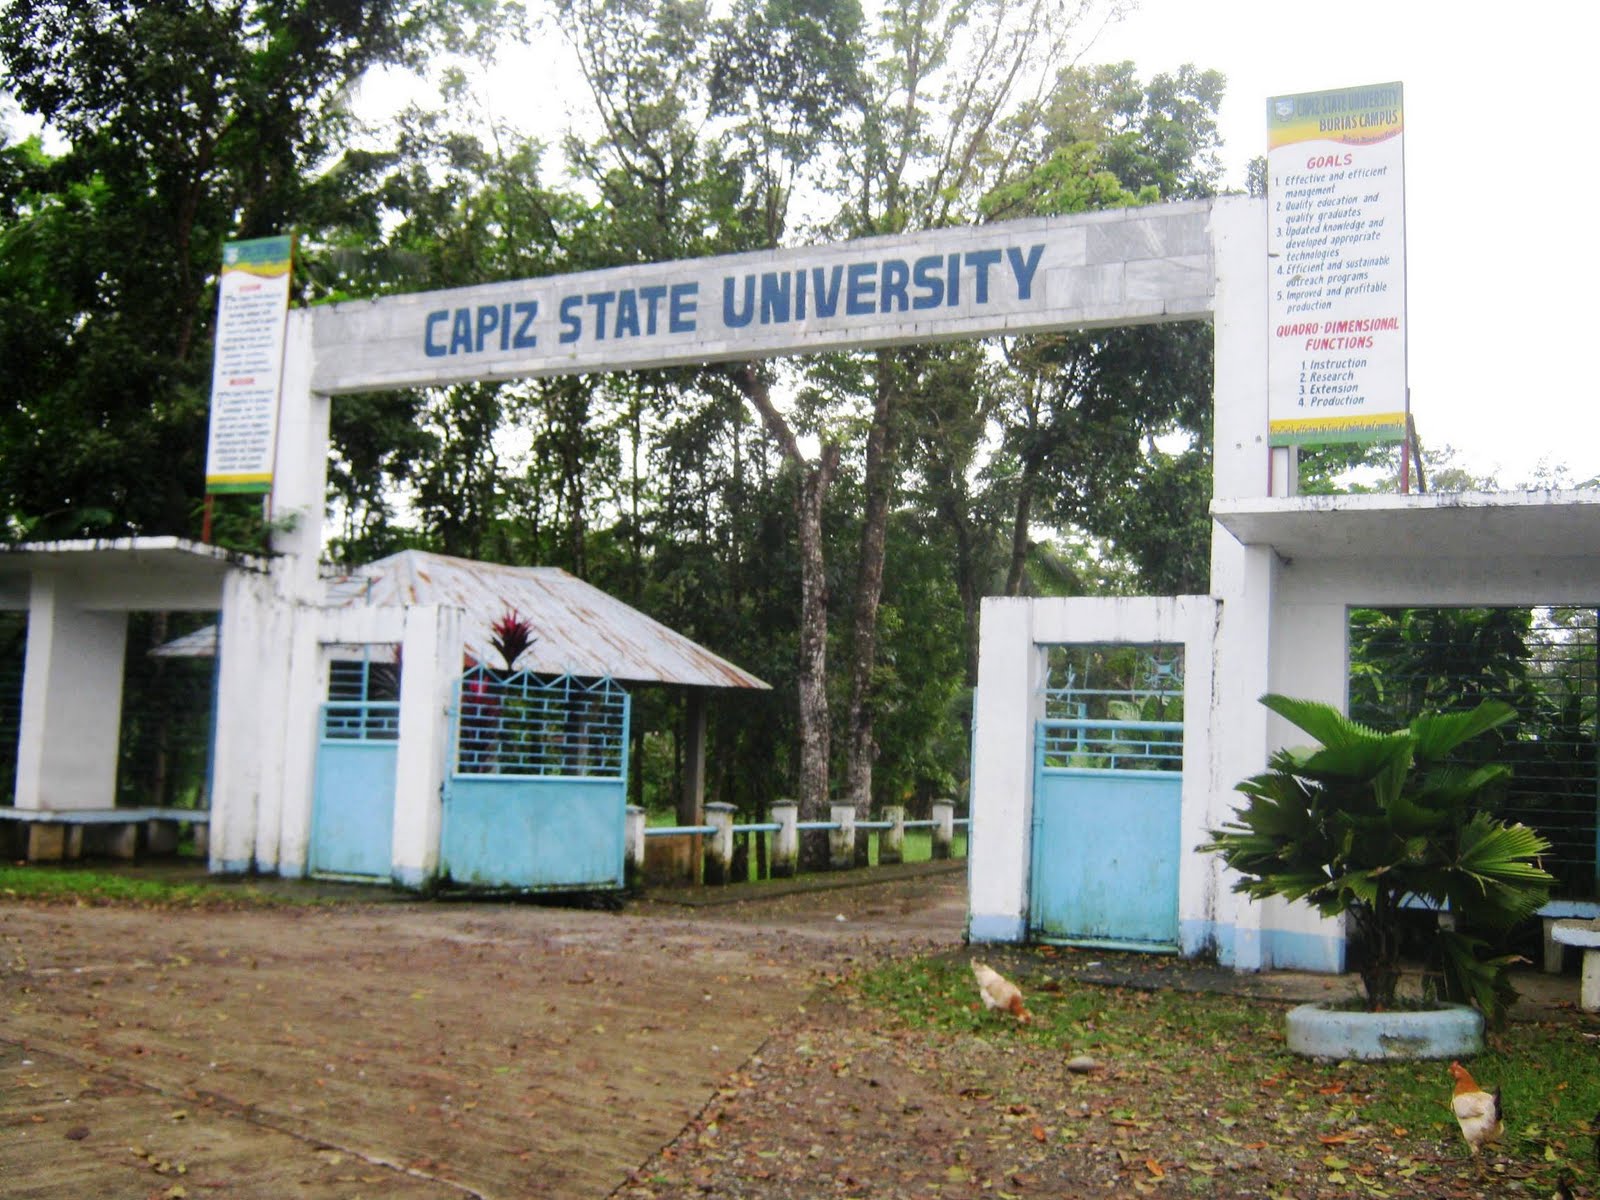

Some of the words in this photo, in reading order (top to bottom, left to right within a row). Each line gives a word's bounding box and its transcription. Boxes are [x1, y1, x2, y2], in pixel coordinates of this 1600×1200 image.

[1320, 117, 1357, 132] BURIAS
[1359, 109, 1398, 128] CAMPUS
[1307, 153, 1352, 169] GOALS
[1285, 172, 1325, 186] Effective
[1329, 171, 1344, 182] and
[1348, 166, 1387, 179] efficient
[1285, 185, 1335, 199] management
[1285, 200, 1312, 211] Quality
[1317, 196, 1357, 208] education
[1364, 193, 1379, 203] and
[1286, 214, 1313, 225] quality
[1318, 208, 1361, 223] graduates
[1286, 224, 1320, 238] Updated
[1323, 221, 1365, 232] knowledge
[1369, 217, 1384, 227] and
[1286, 236, 1327, 249] developed
[1331, 231, 1381, 245] appropriate
[1287, 248, 1339, 262] technologies
[1287, 261, 1324, 274] Efficient
[1327, 261, 1342, 270] and
[1346, 256, 1390, 268] sustainable
[1327, 272, 1368, 286] programs
[1287, 288, 1322, 301] Improved
[1326, 286, 1341, 296] and
[1345, 282, 1387, 297] profitable
[424, 301, 537, 358] CAPIZ
[559, 281, 699, 344] STATE
[722, 243, 1046, 329] UNIVERSITY
[1287, 301, 1332, 314] production
[1305, 336, 1373, 351] FUNCTIONS
[1310, 358, 1367, 369] Instruction
[1310, 371, 1354, 382] Research
[1310, 383, 1358, 395] Extension
[1310, 395, 1364, 407] Production
